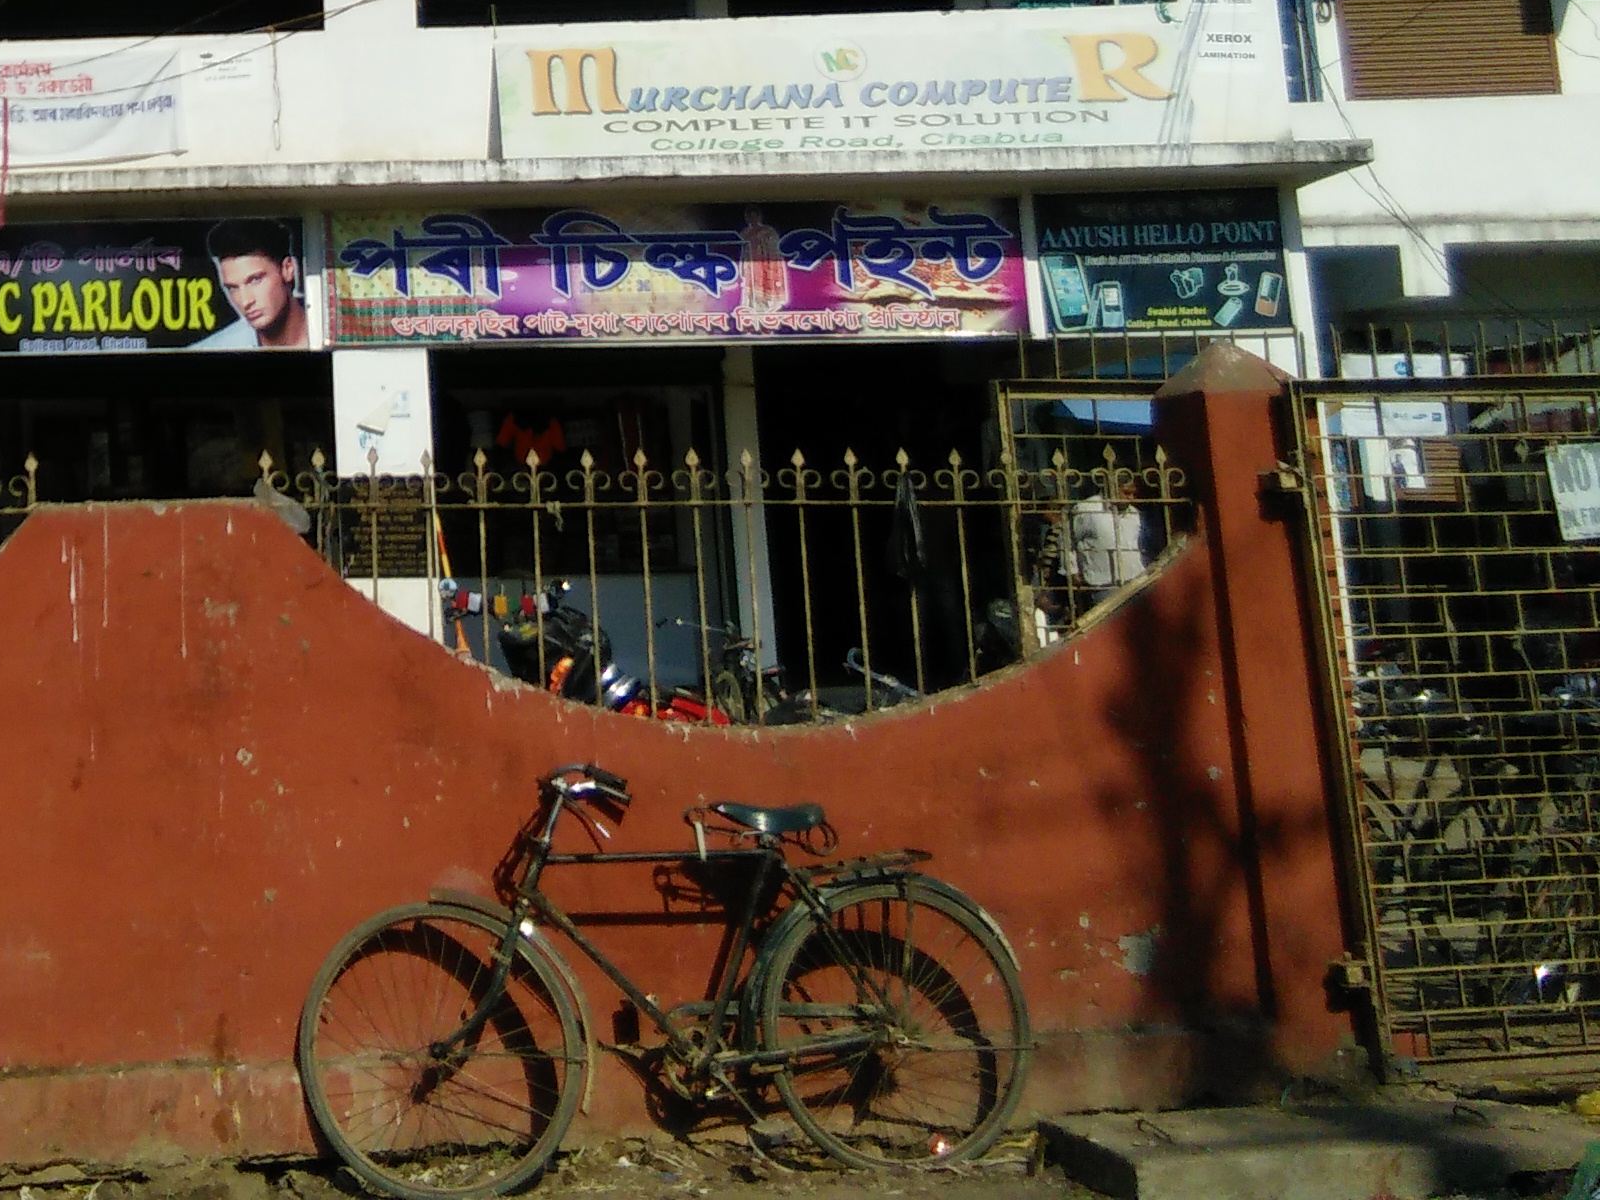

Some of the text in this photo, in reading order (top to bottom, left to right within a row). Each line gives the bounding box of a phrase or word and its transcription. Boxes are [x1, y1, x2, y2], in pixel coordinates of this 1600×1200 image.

[1207, 33, 1252, 44] XEROX
[1198, 51, 1255, 60] LAMINATION
[525, 33, 1175, 116] MURCHANA COMPUTER
[603, 109, 1109, 133] COMPLETE IT SOLUTION
[650, 131, 1064, 151] College Road, Chabua
[1041, 220, 1276, 248] AAYUSH HELLO POINT
[32, 277, 216, 335] PARLOUR
[19, 338, 64, 352] College
[101, 336, 147, 351] Chabua
